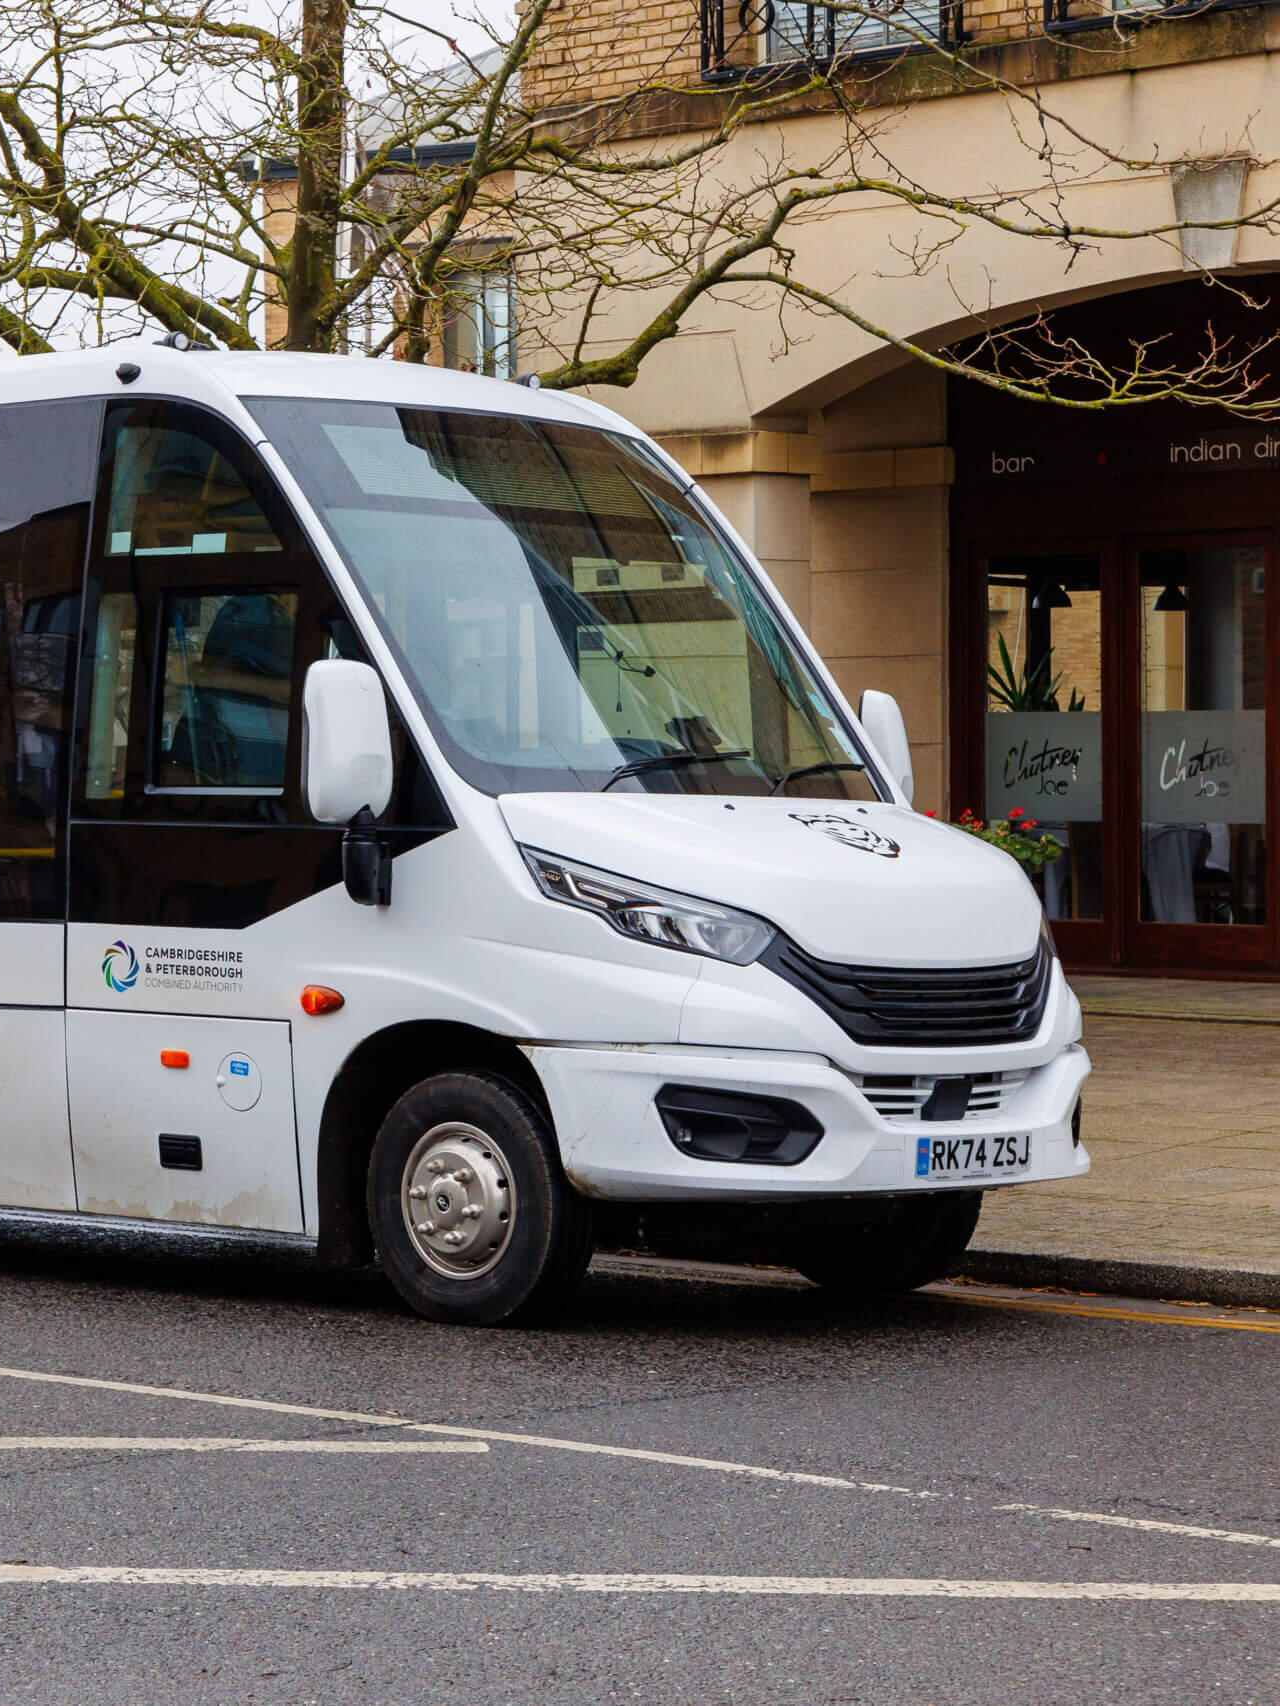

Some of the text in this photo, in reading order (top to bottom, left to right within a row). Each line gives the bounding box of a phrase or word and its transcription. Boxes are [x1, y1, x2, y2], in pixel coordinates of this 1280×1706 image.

[1170, 437, 1241, 463] indian
[992, 451, 1035, 474] bar
[1004, 739, 1082, 788] Chutney
[1160, 738, 1245, 790] Chutne
[1036, 775, 1069, 795] Joe
[145, 947, 243, 962] CAMBRIDGESHIRE
[145, 963, 243, 979] & PETERBOROUGH
[145, 977, 243, 993] COMBINED AUTHORITY
[932, 1135, 1030, 1170] RK74 ZSJ
